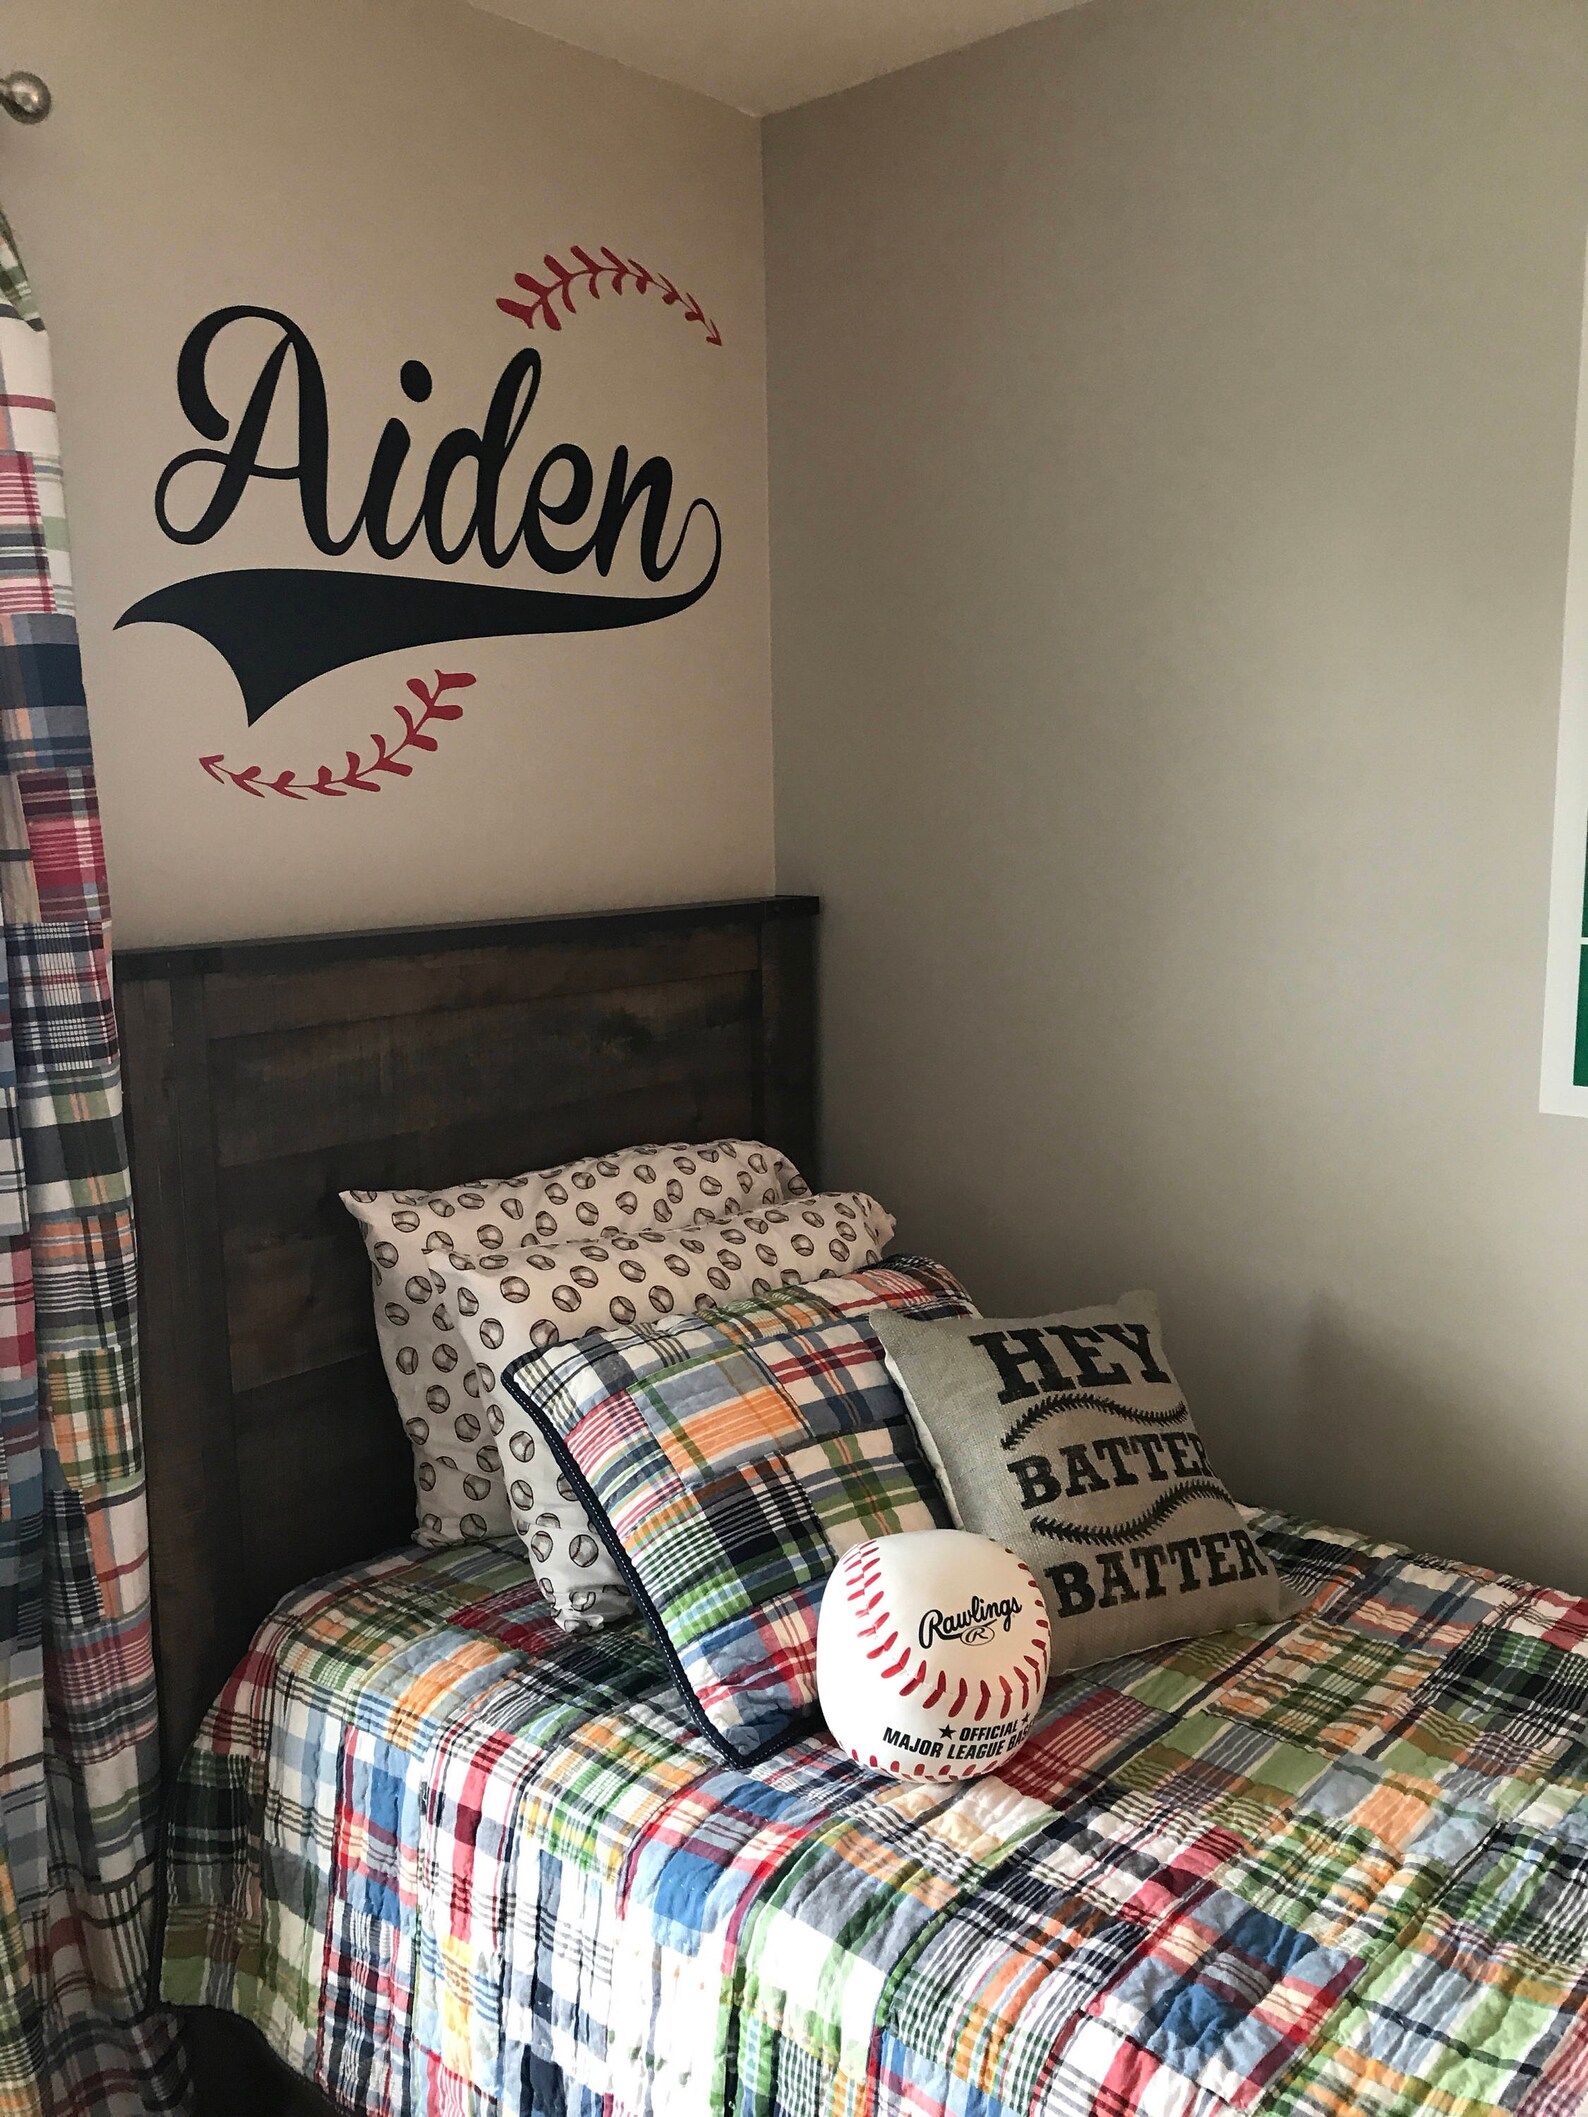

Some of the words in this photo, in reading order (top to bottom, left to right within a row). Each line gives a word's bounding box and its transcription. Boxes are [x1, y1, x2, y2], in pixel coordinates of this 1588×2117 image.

[154, 305, 721, 583] Aiden
[970, 1323, 1172, 1405] HEY
[1007, 1431, 1217, 1510] BATTER
[1043, 1529, 1269, 1618] BATTER
[918, 1595, 1022, 1649] Rawlings
[882, 1726, 944, 1759] MAJOR
[946, 1739, 1006, 1760] LEAGUE
[959, 1719, 1018, 1742] OFFICIAL
